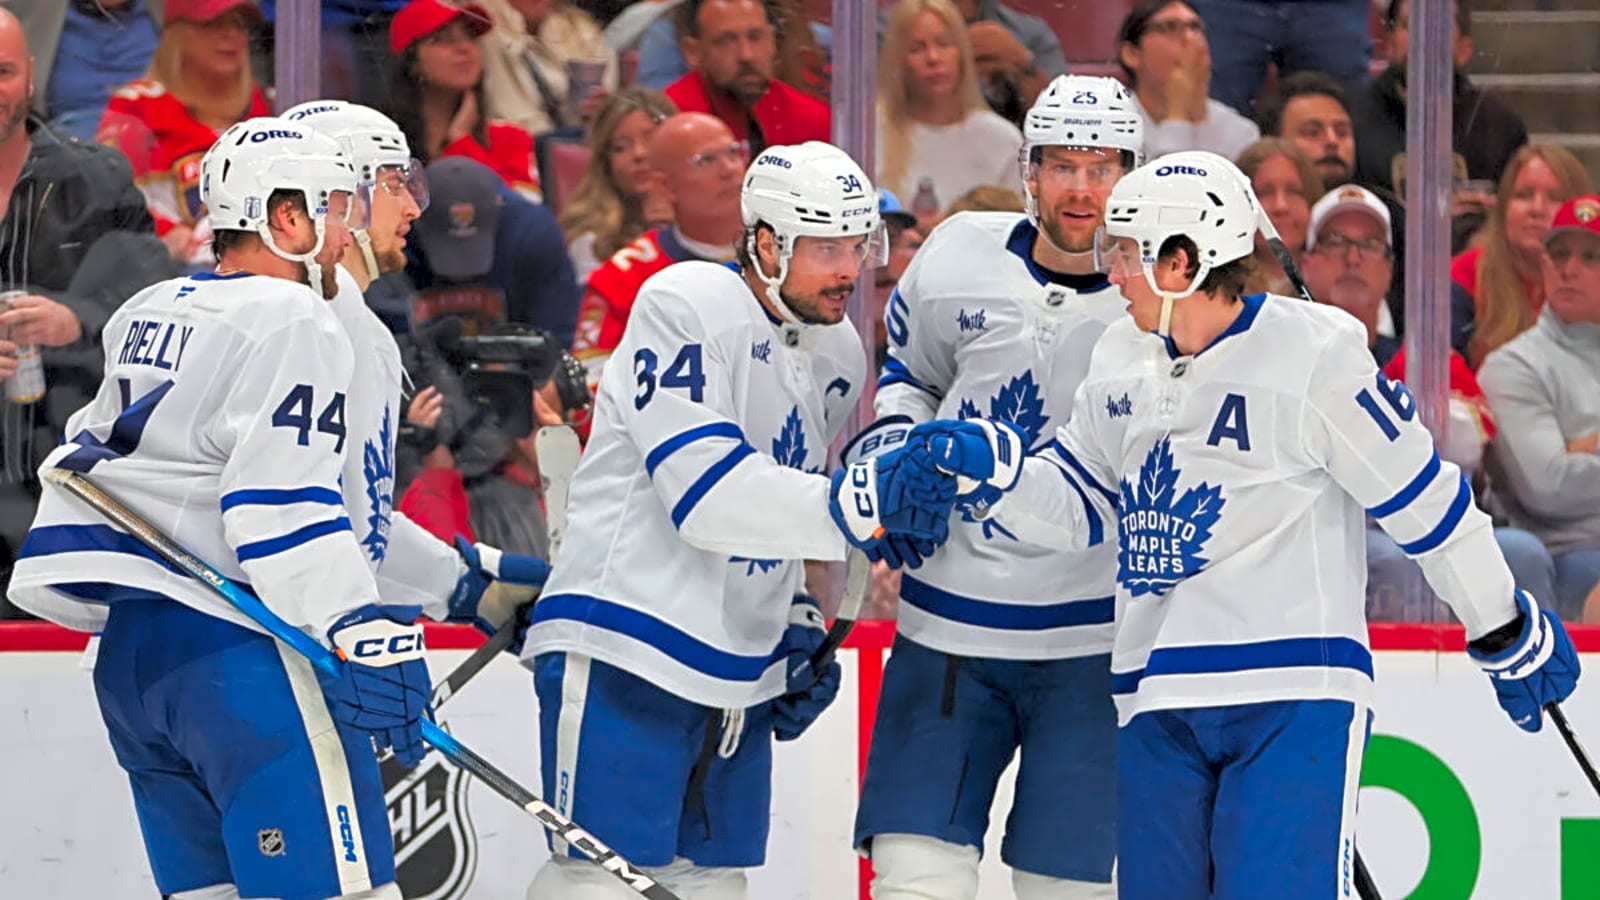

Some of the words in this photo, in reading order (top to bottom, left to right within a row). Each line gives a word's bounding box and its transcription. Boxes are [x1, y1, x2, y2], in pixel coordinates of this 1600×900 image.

[1072, 91, 1097, 105] 25
[250, 129, 303, 143] OREO
[1063, 117, 1102, 126] BAUER
[757, 155, 792, 169] OREO
[1155, 165, 1208, 177] OREO
[836, 174, 863, 193] 34
[118, 320, 193, 372] RIELLY
[633, 342, 706, 412] 34
[272, 383, 346, 454] 44
[1206, 393, 1251, 451] A
[1354, 368, 1417, 443] 16
[852, 460, 874, 518] CC
[1121, 510, 1196, 542] TORONTO
[1128, 534, 1182, 556] MAPLE
[1128, 554, 1184, 575] LEAFS
[387, 779, 443, 845] HL
[335, 803, 358, 864] CCM
[524, 799, 656, 893] CCM
